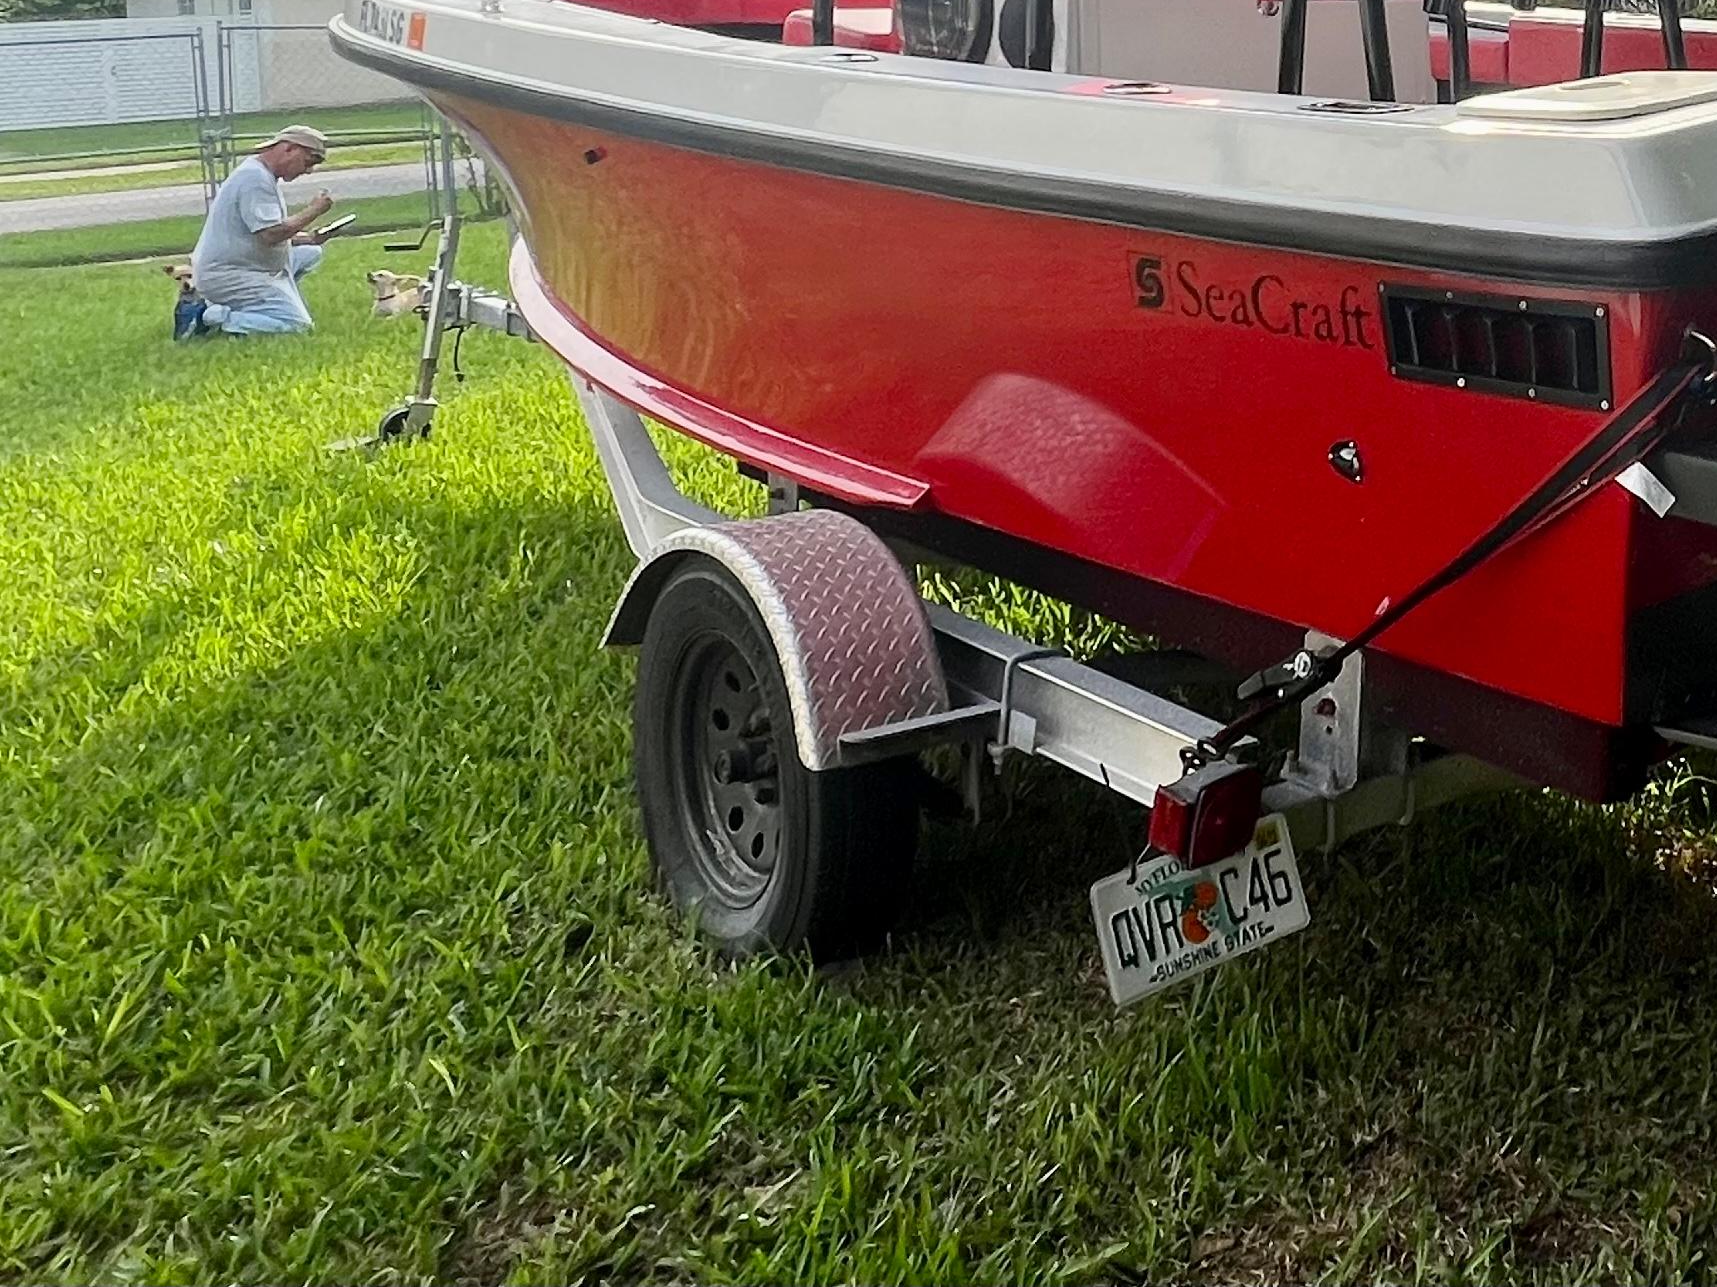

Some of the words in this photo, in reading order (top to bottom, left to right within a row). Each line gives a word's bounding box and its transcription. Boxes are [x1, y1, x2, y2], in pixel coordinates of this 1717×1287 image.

[1176, 260, 1375, 349] SeaCraft
[1219, 848, 1293, 926] C46
[1156, 940, 1221, 981] SUNSHINE
[1224, 921, 1266, 951] STATE
